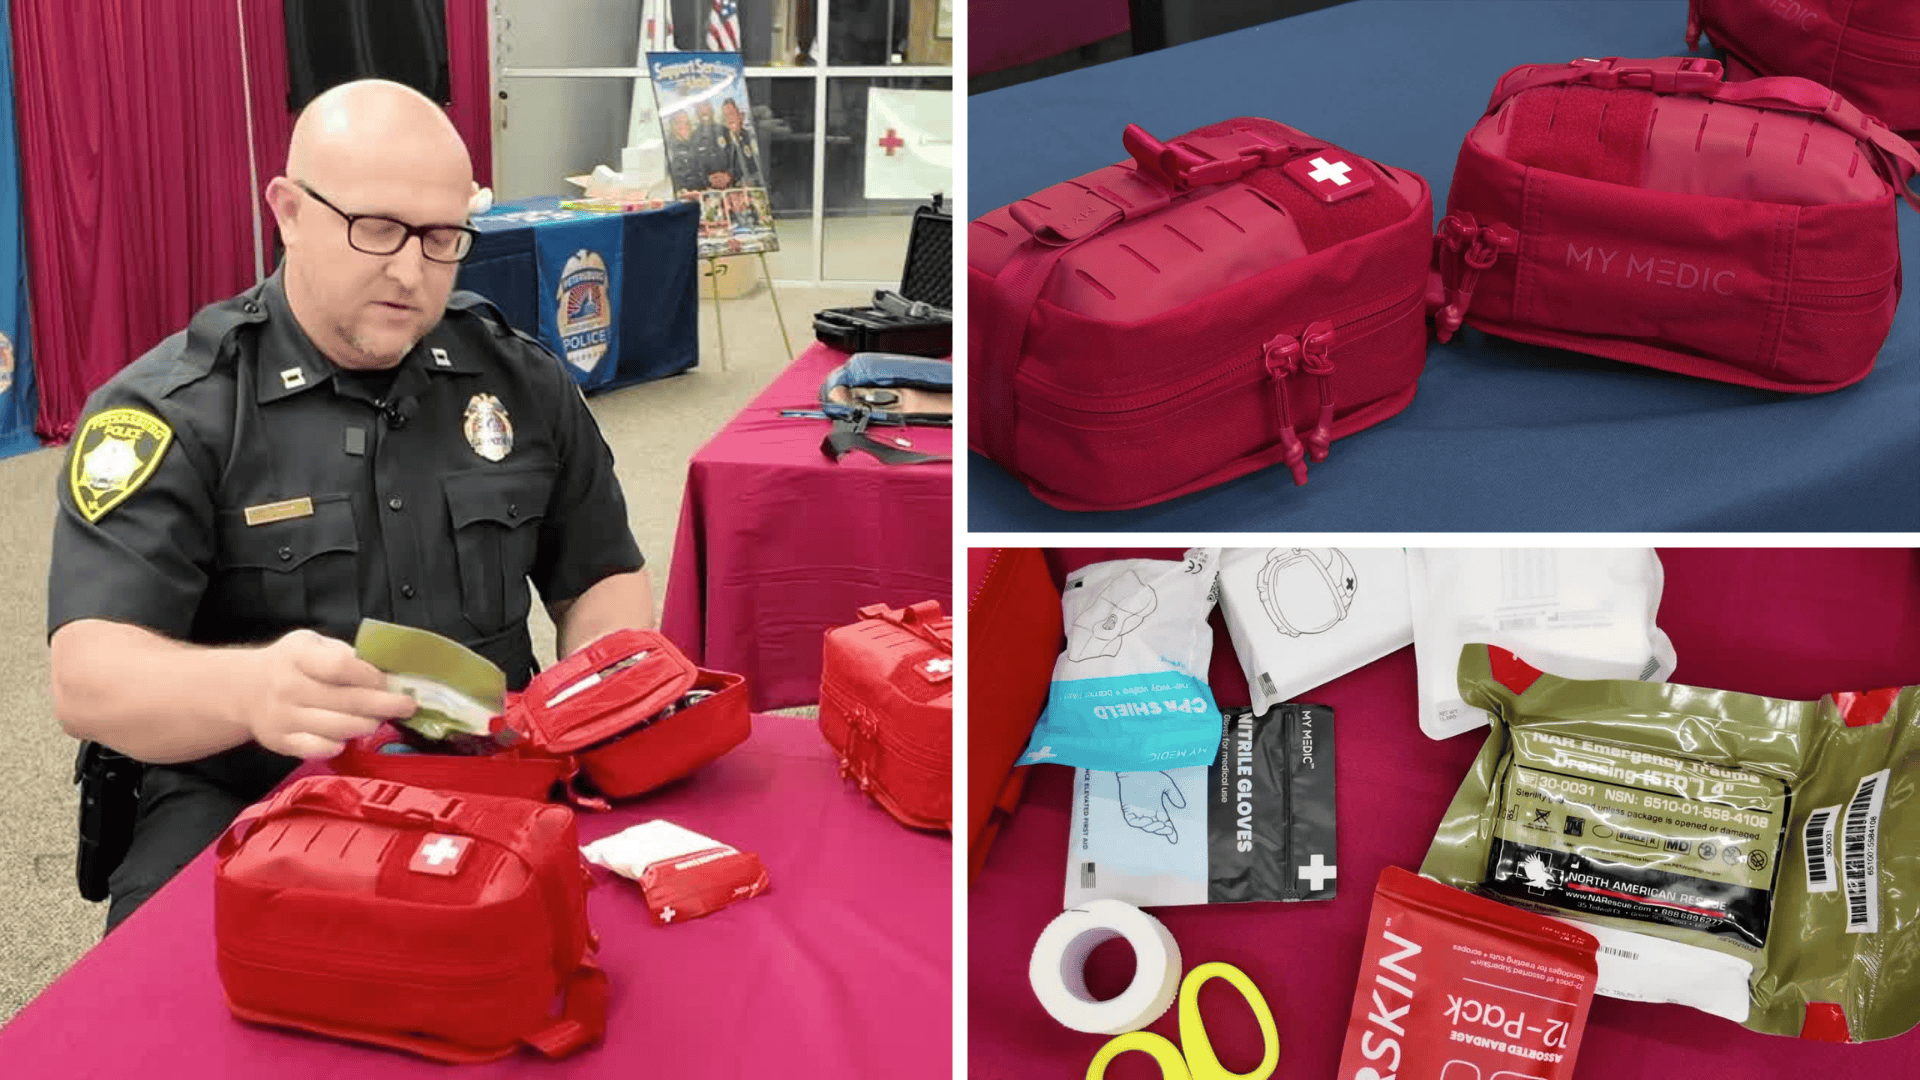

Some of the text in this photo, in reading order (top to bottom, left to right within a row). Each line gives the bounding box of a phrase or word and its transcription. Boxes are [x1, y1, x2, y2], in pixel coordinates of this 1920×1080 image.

[1566, 242, 1736, 297] MY MEDIC
[563, 329, 606, 351] POLICE
[104, 425, 143, 439] POLICE
[1093, 697, 1208, 719] CPR SHIELD
[1222, 714, 1231, 738] Gloves
[1302, 711, 1312, 728] MY
[1149, 747, 1208, 762] MY MEDIC
[1222, 737, 1230, 750] for
[1221, 751, 1229, 786] medical
[1533, 732, 1761, 784] NAR Emergency Trauma
[1554, 751, 1638, 784] Dressing
[1237, 712, 1253, 853] NITRILE GLOVES
[1515, 788, 1547, 803] Sterility
[1598, 803, 1625, 815] unless
[1626, 809, 1663, 823] package
[1665, 816, 1673, 824] is
[1675, 819, 1708, 832] opened
[1709, 824, 1718, 832] or
[1539, 776, 1595, 797] 30-0031
[1605, 788, 1638, 805] NSN:
[1644, 796, 1769, 828] 6510-01-558-4108
[1666, 840, 1689, 852] MD
[1565, 891, 1652, 913] www.NARescue.com
[1568, 871, 1728, 911] NORTH AMERICAN RESUE
[1577, 901, 1587, 909] 35
[1452, 944, 1483, 957] scrapes
[1489, 953, 1506, 961] cuts
[1506, 955, 1536, 970] treating
[1513, 970, 1546, 980] assorted
[1549, 967, 1585, 982] Bandages
[1442, 994, 1570, 1049] 12-Pack
[1449, 1029, 1564, 1064] ASSORTED BANDAGE
